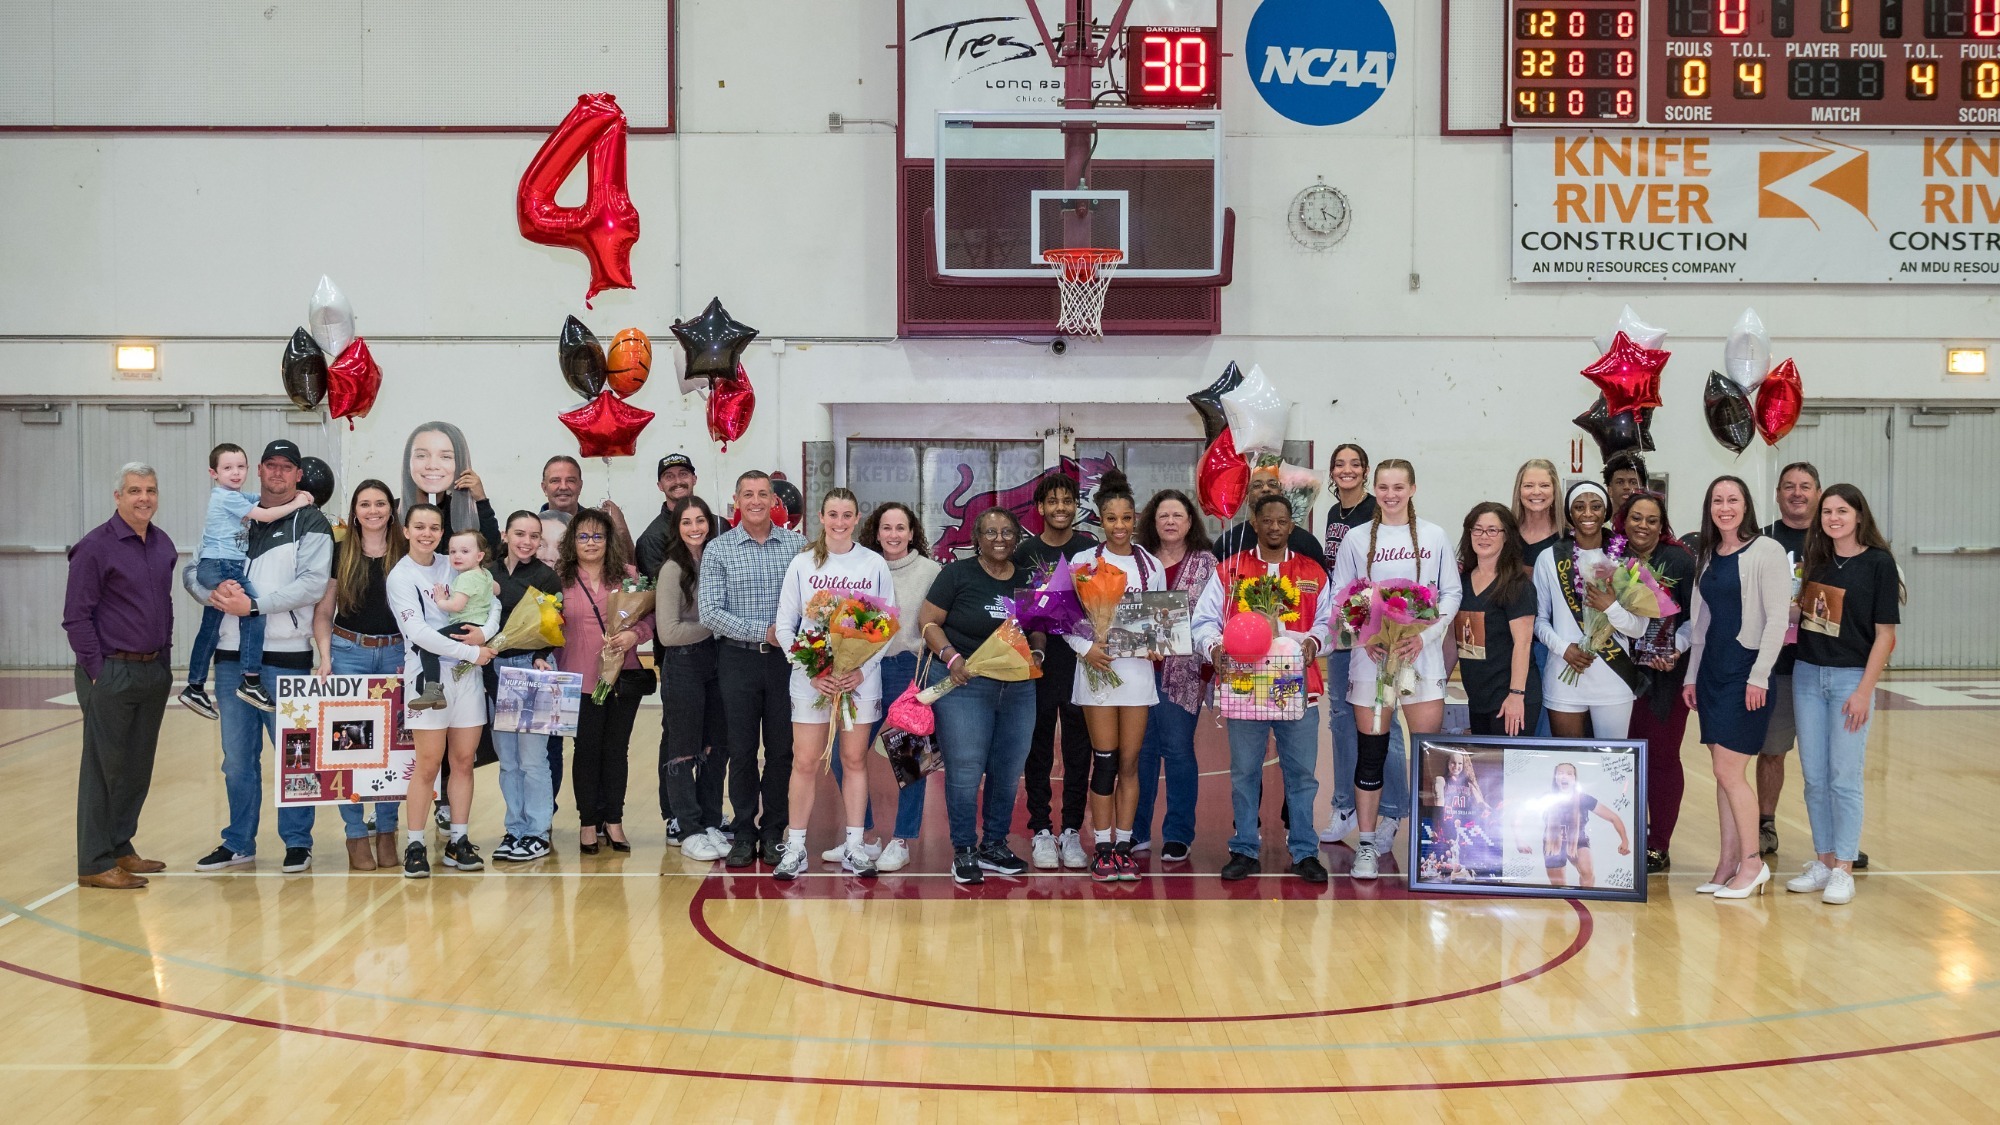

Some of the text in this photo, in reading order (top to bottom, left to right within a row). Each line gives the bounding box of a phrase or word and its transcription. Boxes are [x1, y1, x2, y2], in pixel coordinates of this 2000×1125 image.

[1530, 10, 1633, 37] 12 0 0
[910, 17, 1037, 83] Tres
[1522, 50, 1633, 76] 32 0 0
[1666, 42, 1713, 57] FOULS
[1731, 43, 1771, 57] T.O.L.
[1785, 43, 1840, 58] PLAYER
[1850, 43, 1888, 58] FOUL
[1903, 44, 1944, 58] T.O.L.
[1143, 36, 1206, 92] 30
[1260, 46, 1388, 89] NCAA
[1683, 60, 2000, 98] 0 4 4 0
[1519, 90, 1632, 115] 41 0 0
[1664, 106, 2000, 122] SCORE MATCH SCOR
[1554, 136, 1712, 177] KNIFE
[1553, 183, 1713, 224] RIVER
[1921, 184, 2000, 224] RIV
[1521, 231, 1747, 251] CONSTRUCTION
[1889, 231, 2000, 250] CONSTR
[1532, 261, 1736, 273] AN MDU RESOURCES COMPANY
[1900, 262, 1999, 273] AN MDU RESOU
[809, 574, 872, 590] Wildcats
[279, 677, 363, 698] BRANDY
[329, 770, 346, 800] 4
